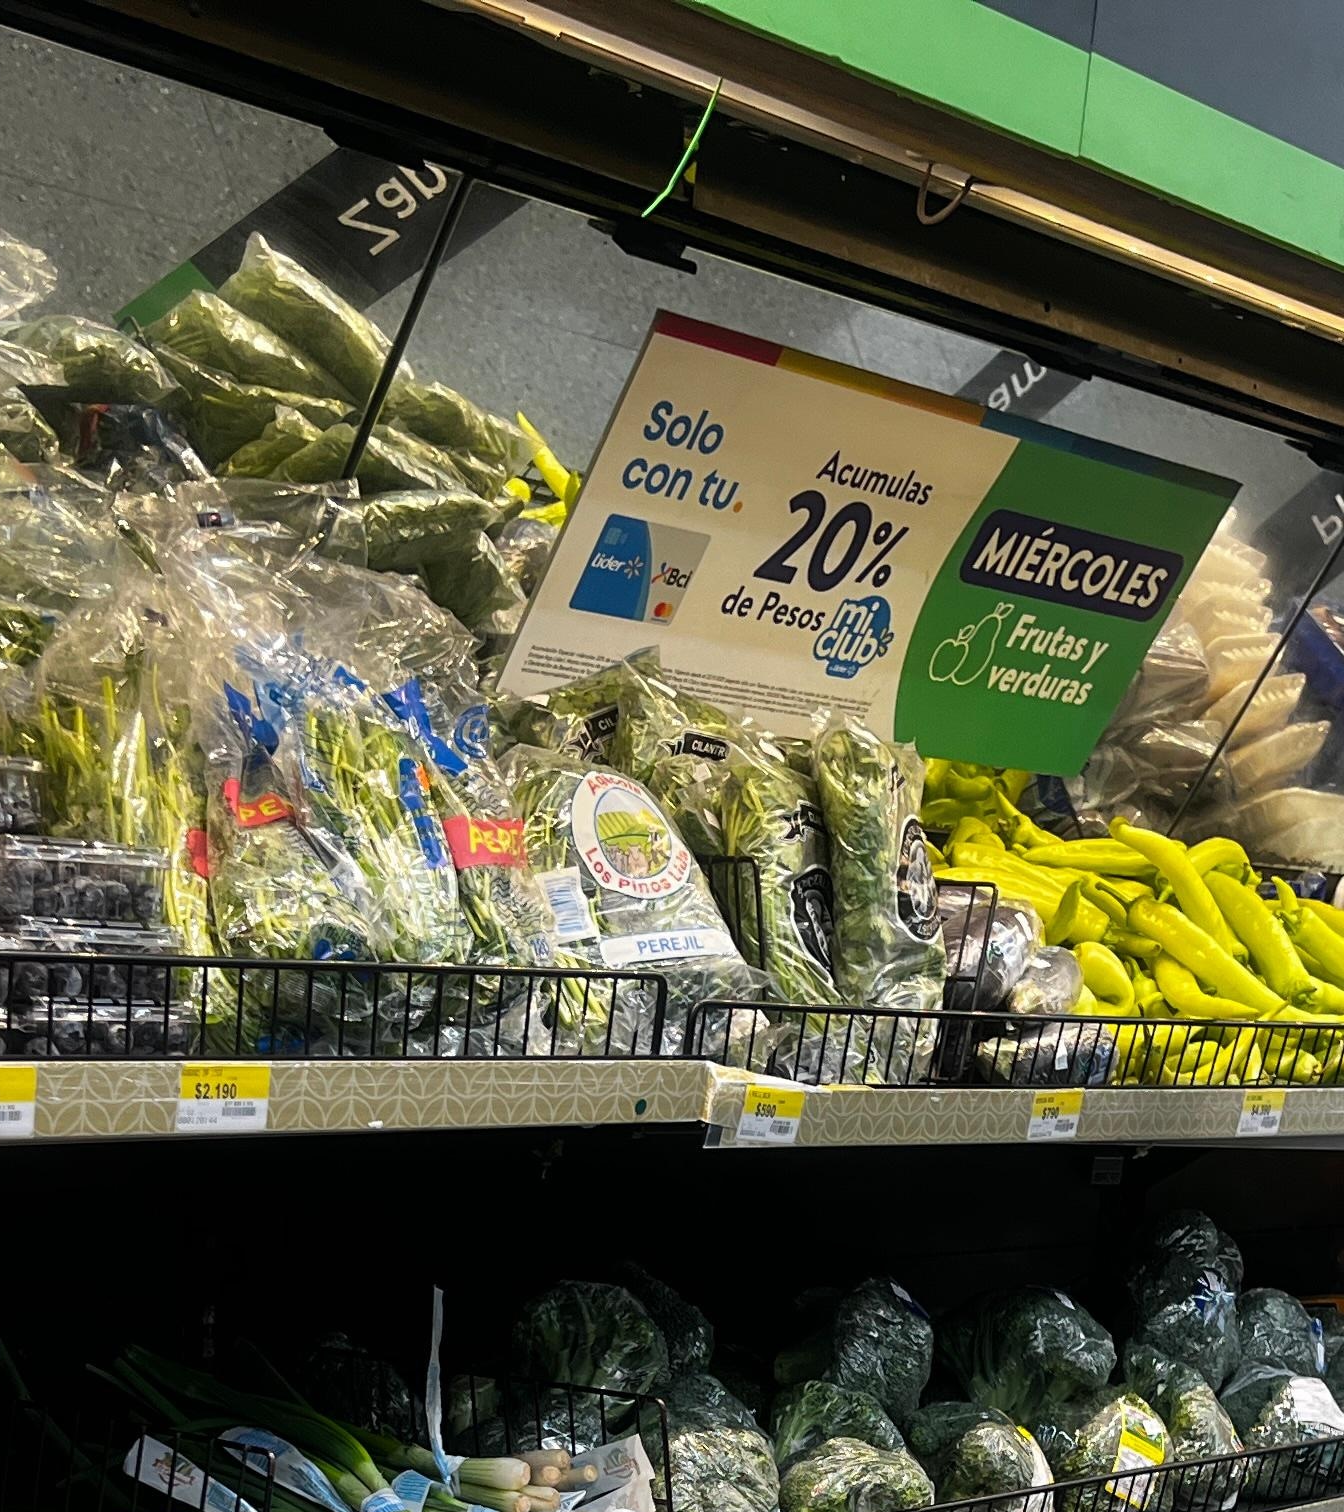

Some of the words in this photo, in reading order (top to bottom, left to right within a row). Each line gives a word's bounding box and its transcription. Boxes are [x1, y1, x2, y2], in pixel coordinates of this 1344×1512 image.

[643, 400, 724, 455] Solo
[622, 458, 693, 501] con
[816, 450, 934, 506] Acumulas
[753, 489, 910, 593] 20%
[972, 526, 1169, 609] MIÉRCOLES
[721, 585, 754, 618] de
[756, 591, 826, 632] Pesos
[832, 600, 881, 635] mi
[814, 625, 880, 665] club
[1005, 613, 1089, 662] Frutas
[1080, 641, 1110, 675] y
[987, 663, 1093, 706] verduras
[691, 738, 727, 758] CILANTR
[584, 846, 612, 885] Los
[617, 877, 673, 895] Pinos
[636, 935, 706, 955] PEREJIL
[194, 1083, 238, 1100] $2.190
